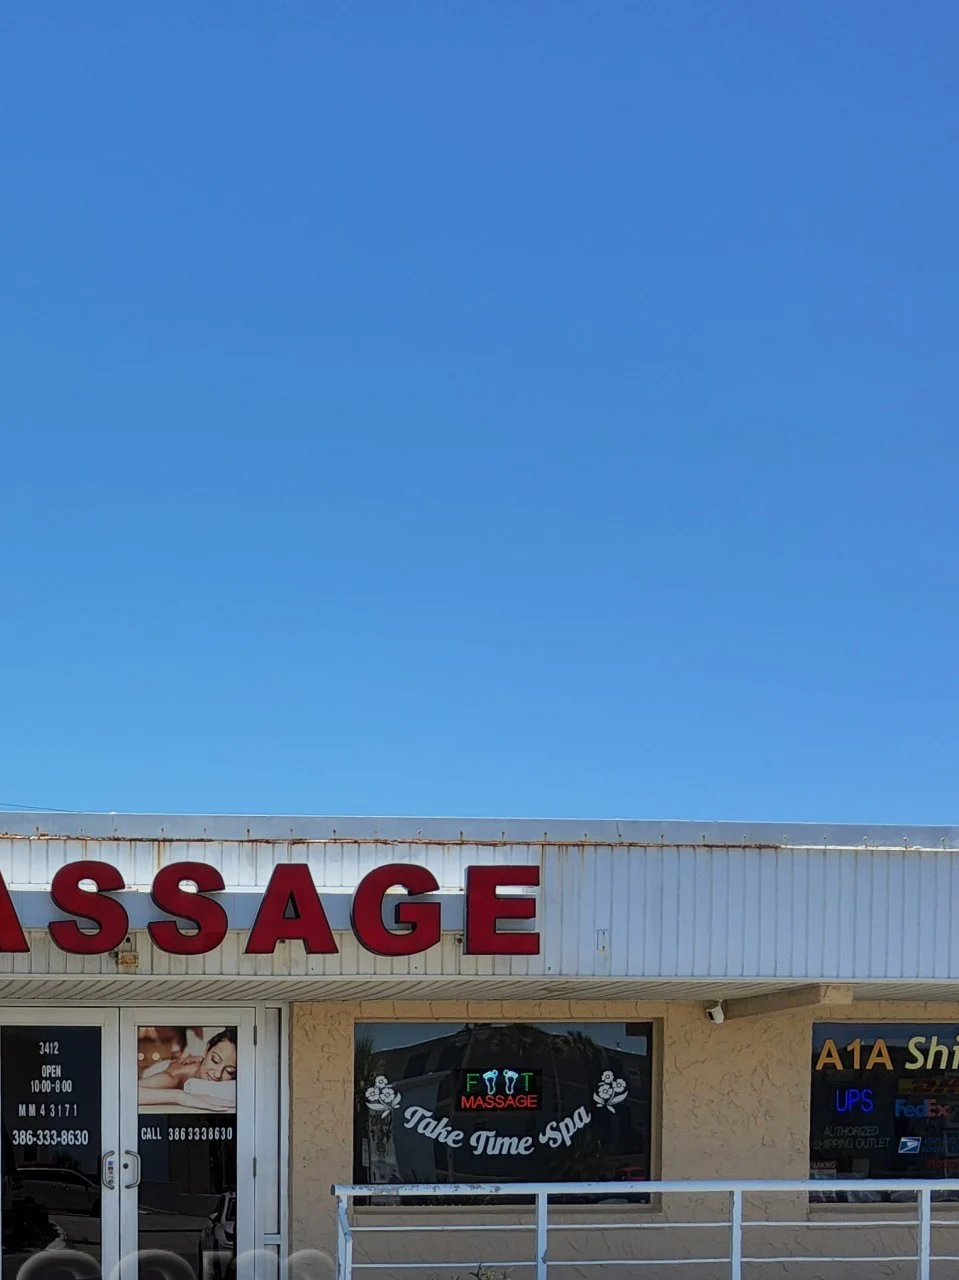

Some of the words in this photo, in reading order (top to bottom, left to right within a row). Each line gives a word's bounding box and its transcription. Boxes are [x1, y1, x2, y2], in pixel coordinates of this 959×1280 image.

[39, 1041, 59, 1055] 3412
[815, 1038, 894, 1070] A1A
[41, 1064, 62, 1078] OPEN
[461, 1094, 538, 1109] MASSAGE
[836, 1089, 874, 1112] UPS
[895, 1098, 952, 1117] FedEx
[12, 1129, 89, 1146] 386-333-8630
[141, 1127, 162, 1140] CALL
[403, 1105, 465, 1148] Take
[469, 1130, 535, 1156] Time
[538, 1105, 592, 1149] Spa
[823, 1125, 879, 1137] AUTHORIZED
[813, 1137, 853, 1150] SHIPPING
[855, 1137, 890, 1149] OUTLET
